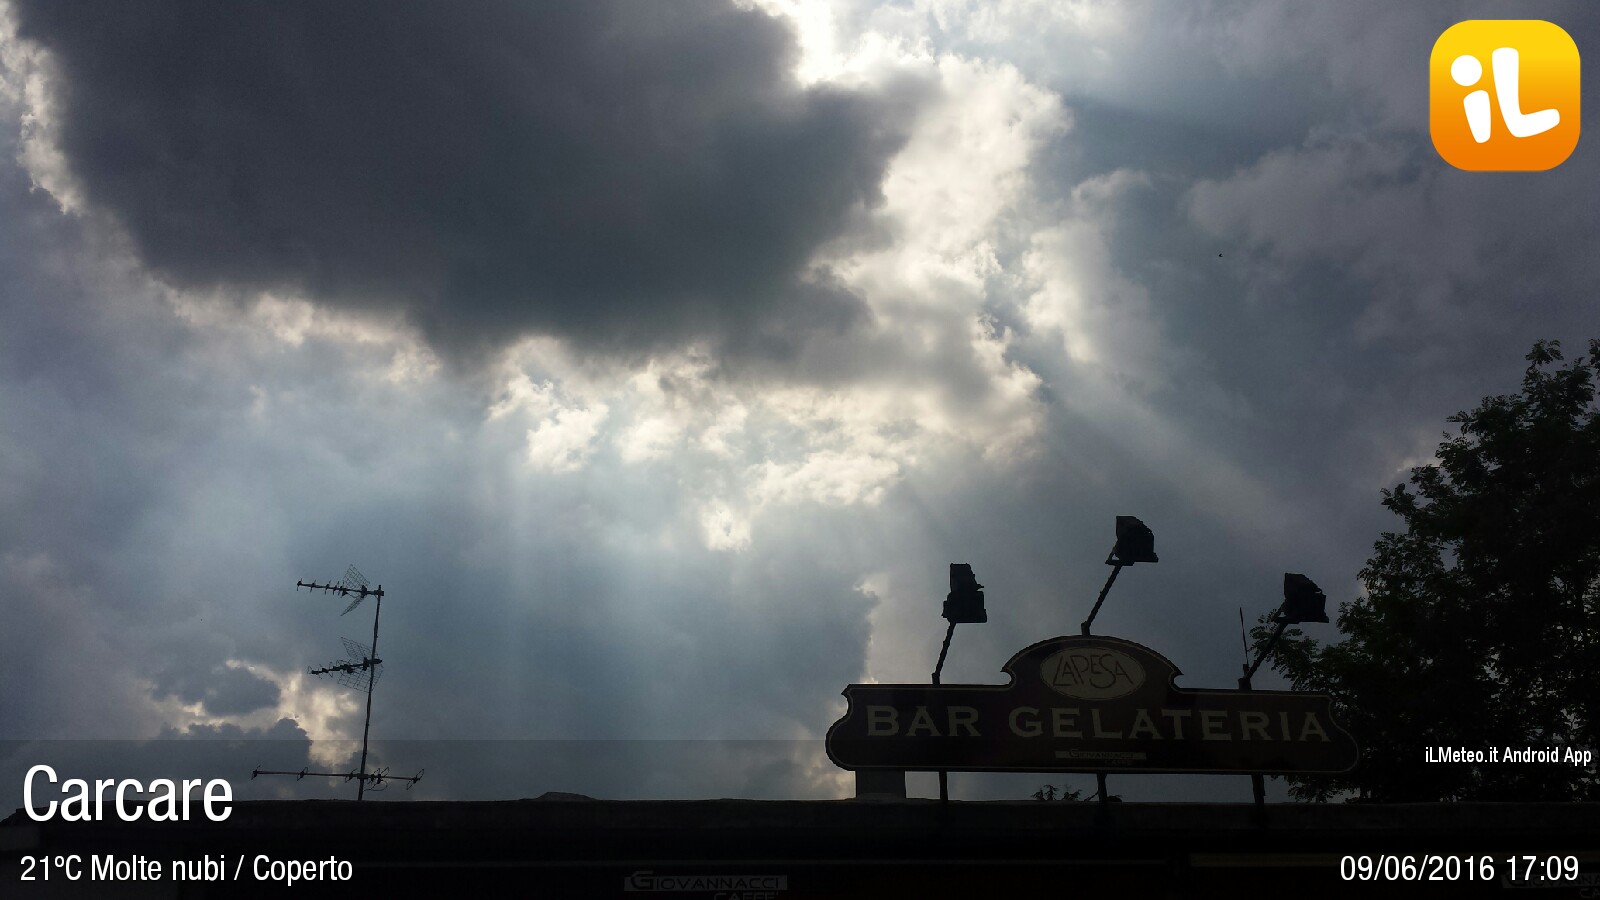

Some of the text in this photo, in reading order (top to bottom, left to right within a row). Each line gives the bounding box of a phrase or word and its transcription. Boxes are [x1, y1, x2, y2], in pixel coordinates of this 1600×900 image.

[1052, 653, 1134, 689] LAPESA
[865, 704, 1331, 743] BAR GELATERIA
